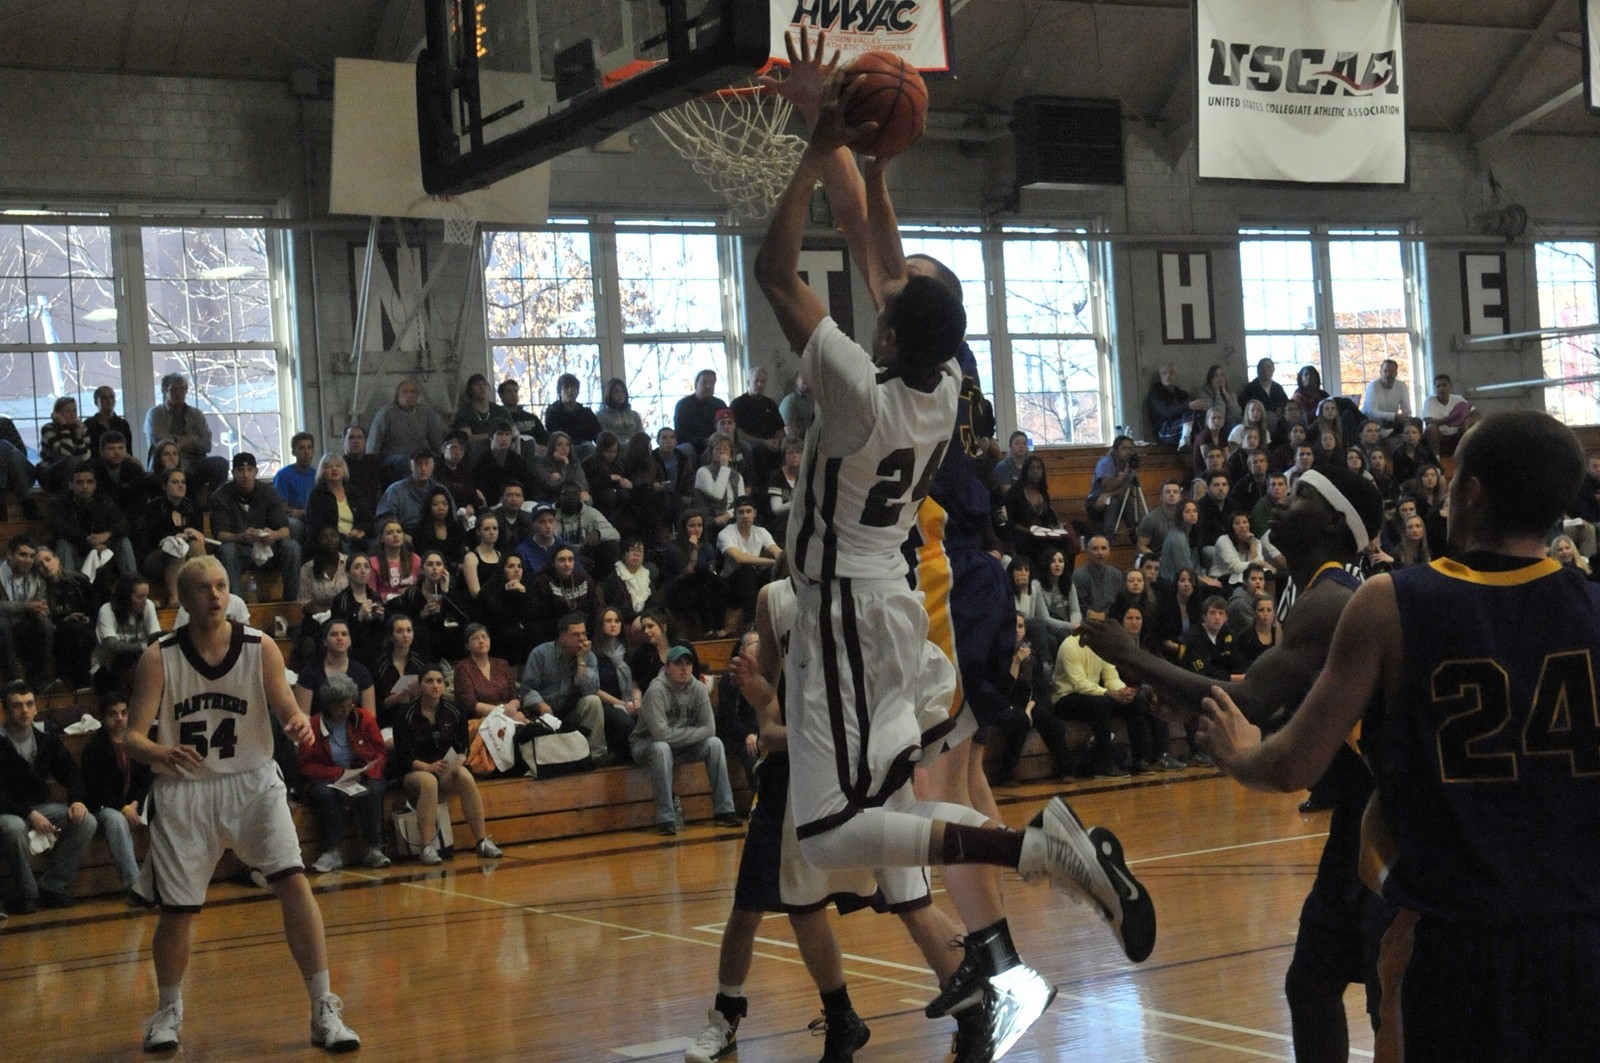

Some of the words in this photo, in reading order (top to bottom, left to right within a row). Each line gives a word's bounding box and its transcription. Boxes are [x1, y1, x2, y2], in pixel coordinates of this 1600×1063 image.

[826, 42, 860, 51] ATHLETIC
[861, 43, 912, 51] CONFERENCE
[853, 36, 881, 45] VALLEY
[1208, 39, 1399, 97] USCAA
[1207, 96, 1241, 108] UNITED
[1242, 99, 1264, 112] STATES
[1265, 103, 1312, 117] COLLEGIATE
[1313, 105, 1346, 118] ATHLETIC
[1346, 104, 1400, 118] ASSOCIATION
[353, 247, 426, 352] N
[1161, 253, 1211, 340] H
[1465, 254, 1504, 335] E
[174, 692, 247, 721] PANTHERS
[1430, 648, 1600, 783] 24
[180, 718, 238, 760] 54
